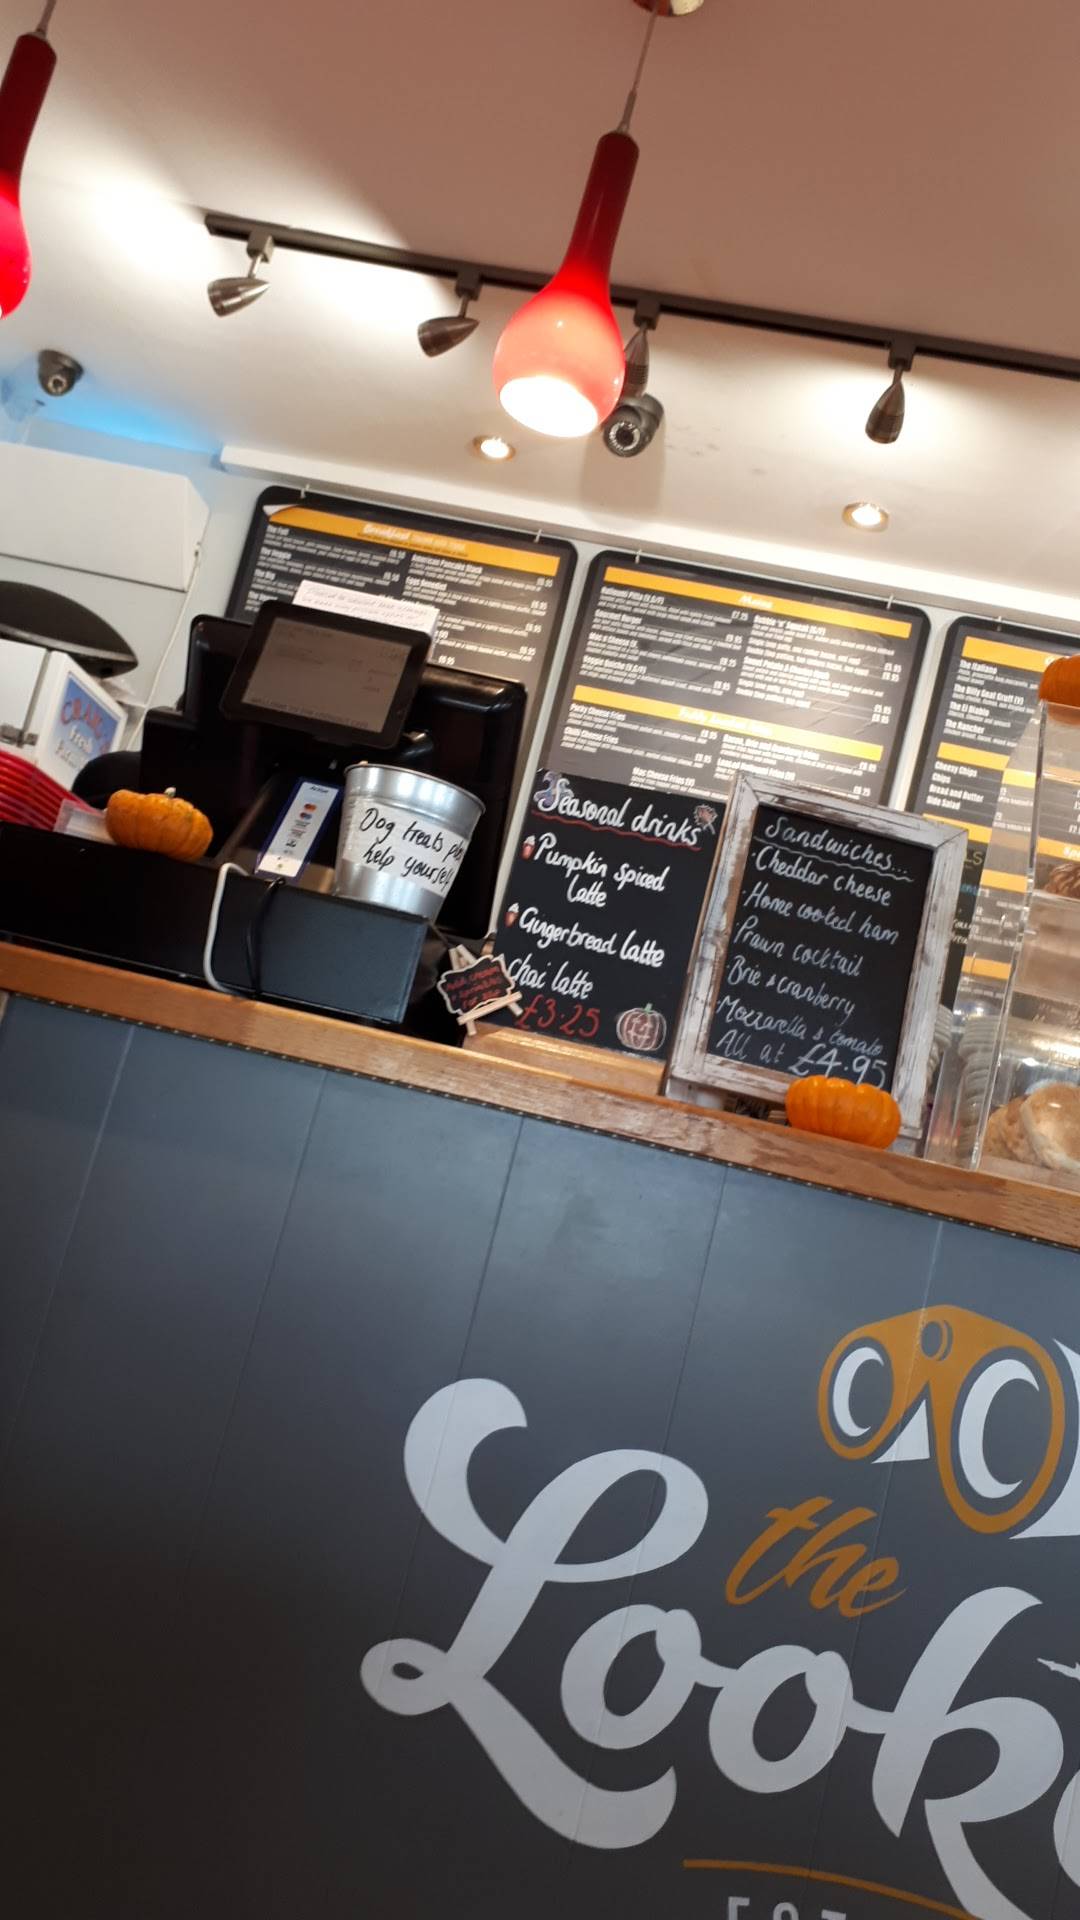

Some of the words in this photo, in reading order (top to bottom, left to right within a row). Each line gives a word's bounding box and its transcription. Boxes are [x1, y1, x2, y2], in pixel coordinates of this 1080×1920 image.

[960, 660, 972, 669] The
[973, 663, 996, 674] Italiano
[950, 702, 962, 710] The
[963, 704, 970, 713] El
[971, 706, 989, 716] Diablo
[954, 684, 965, 693] The
[966, 687, 980, 697] Billy
[981, 690, 996, 699] Goat
[997, 693, 1013, 702] Gruff
[946, 719, 957, 728] The
[957, 722, 984, 733] Rancher
[932, 773, 950, 783] Chips
[935, 762, 957, 773] Cheesy
[959, 767, 977, 777] Chips
[927, 796, 940, 805] Side
[942, 799, 960, 809] Salad
[929, 784, 946, 795] Bread
[947, 789, 961, 798] and
[963, 792, 983, 802] Butter
[359, 807, 396, 844] Dog
[402, 820, 444, 853] treats
[537, 779, 633, 828] Seasonal
[632, 804, 702, 846] drinks
[363, 844, 395, 872] help
[534, 832, 608, 878] Pumpkin
[755, 846, 828, 885] Cheddar
[744, 880, 792, 916] Home
[860, 915, 900, 944] ham
[518, 907, 618, 955] Gingerbread
[734, 915, 784, 958] Prawn
[728, 954, 760, 986] Brie
[516, 994, 600, 1036] £3.25
[829, 1023, 884, 1056] tomato
[716, 1028, 748, 1060] All
[760, 1041, 784, 1063] at
[788, 1042, 888, 1089] £4.95
[725, 1496, 908, 1618] the
[360, 1378, 1080, 1920] Look
